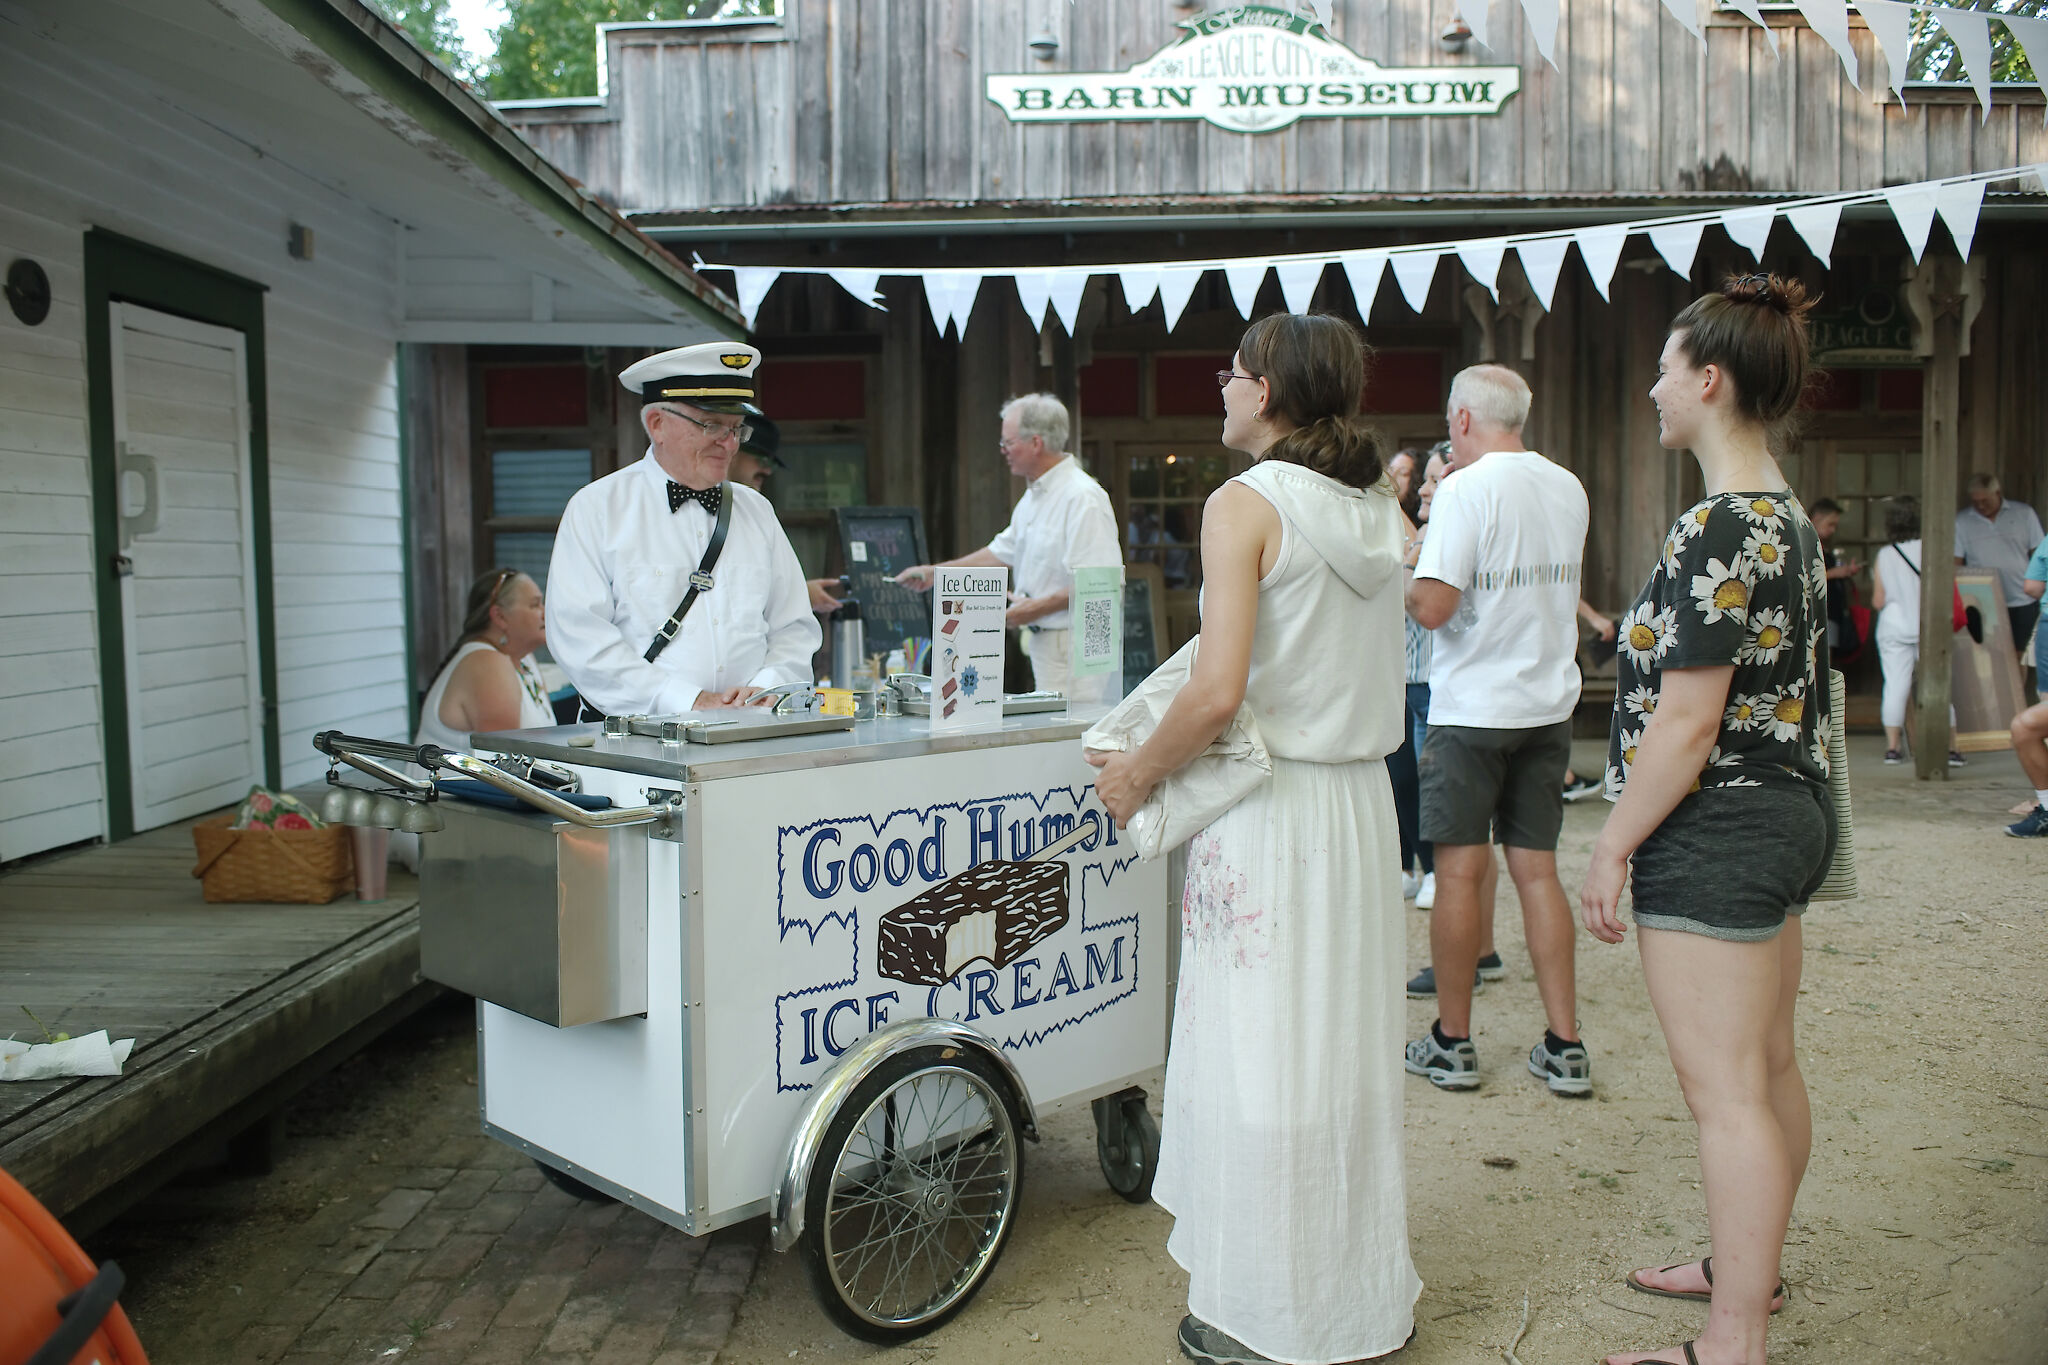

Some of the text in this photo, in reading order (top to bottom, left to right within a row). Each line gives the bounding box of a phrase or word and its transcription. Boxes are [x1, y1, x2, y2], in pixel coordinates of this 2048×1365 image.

[1188, 33, 1317, 78] LEAGUE CITY
[1013, 80, 1497, 111] BARN MUSEUM
[942, 574, 1002, 593] Ice Cream
[964, 674, 975, 687] $2
[802, 816, 948, 899] Good
[799, 991, 900, 1065] ICE
